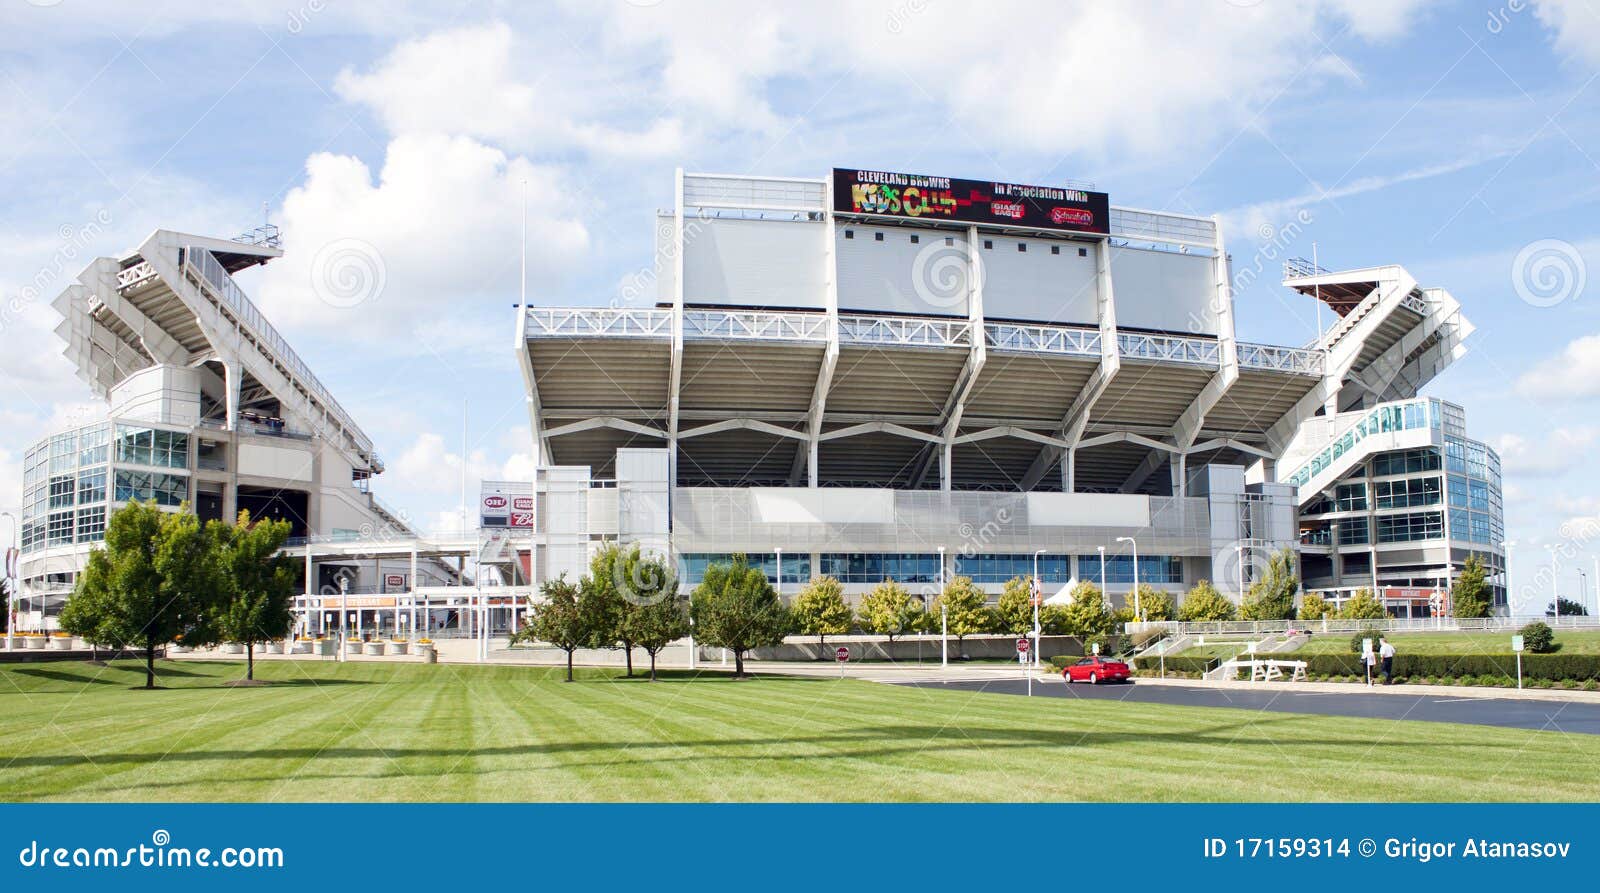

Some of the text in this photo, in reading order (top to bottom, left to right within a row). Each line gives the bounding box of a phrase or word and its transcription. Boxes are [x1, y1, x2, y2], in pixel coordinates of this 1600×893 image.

[857, 170, 951, 190] CLEVELAND BROWNS
[994, 183, 1088, 203] In Association With
